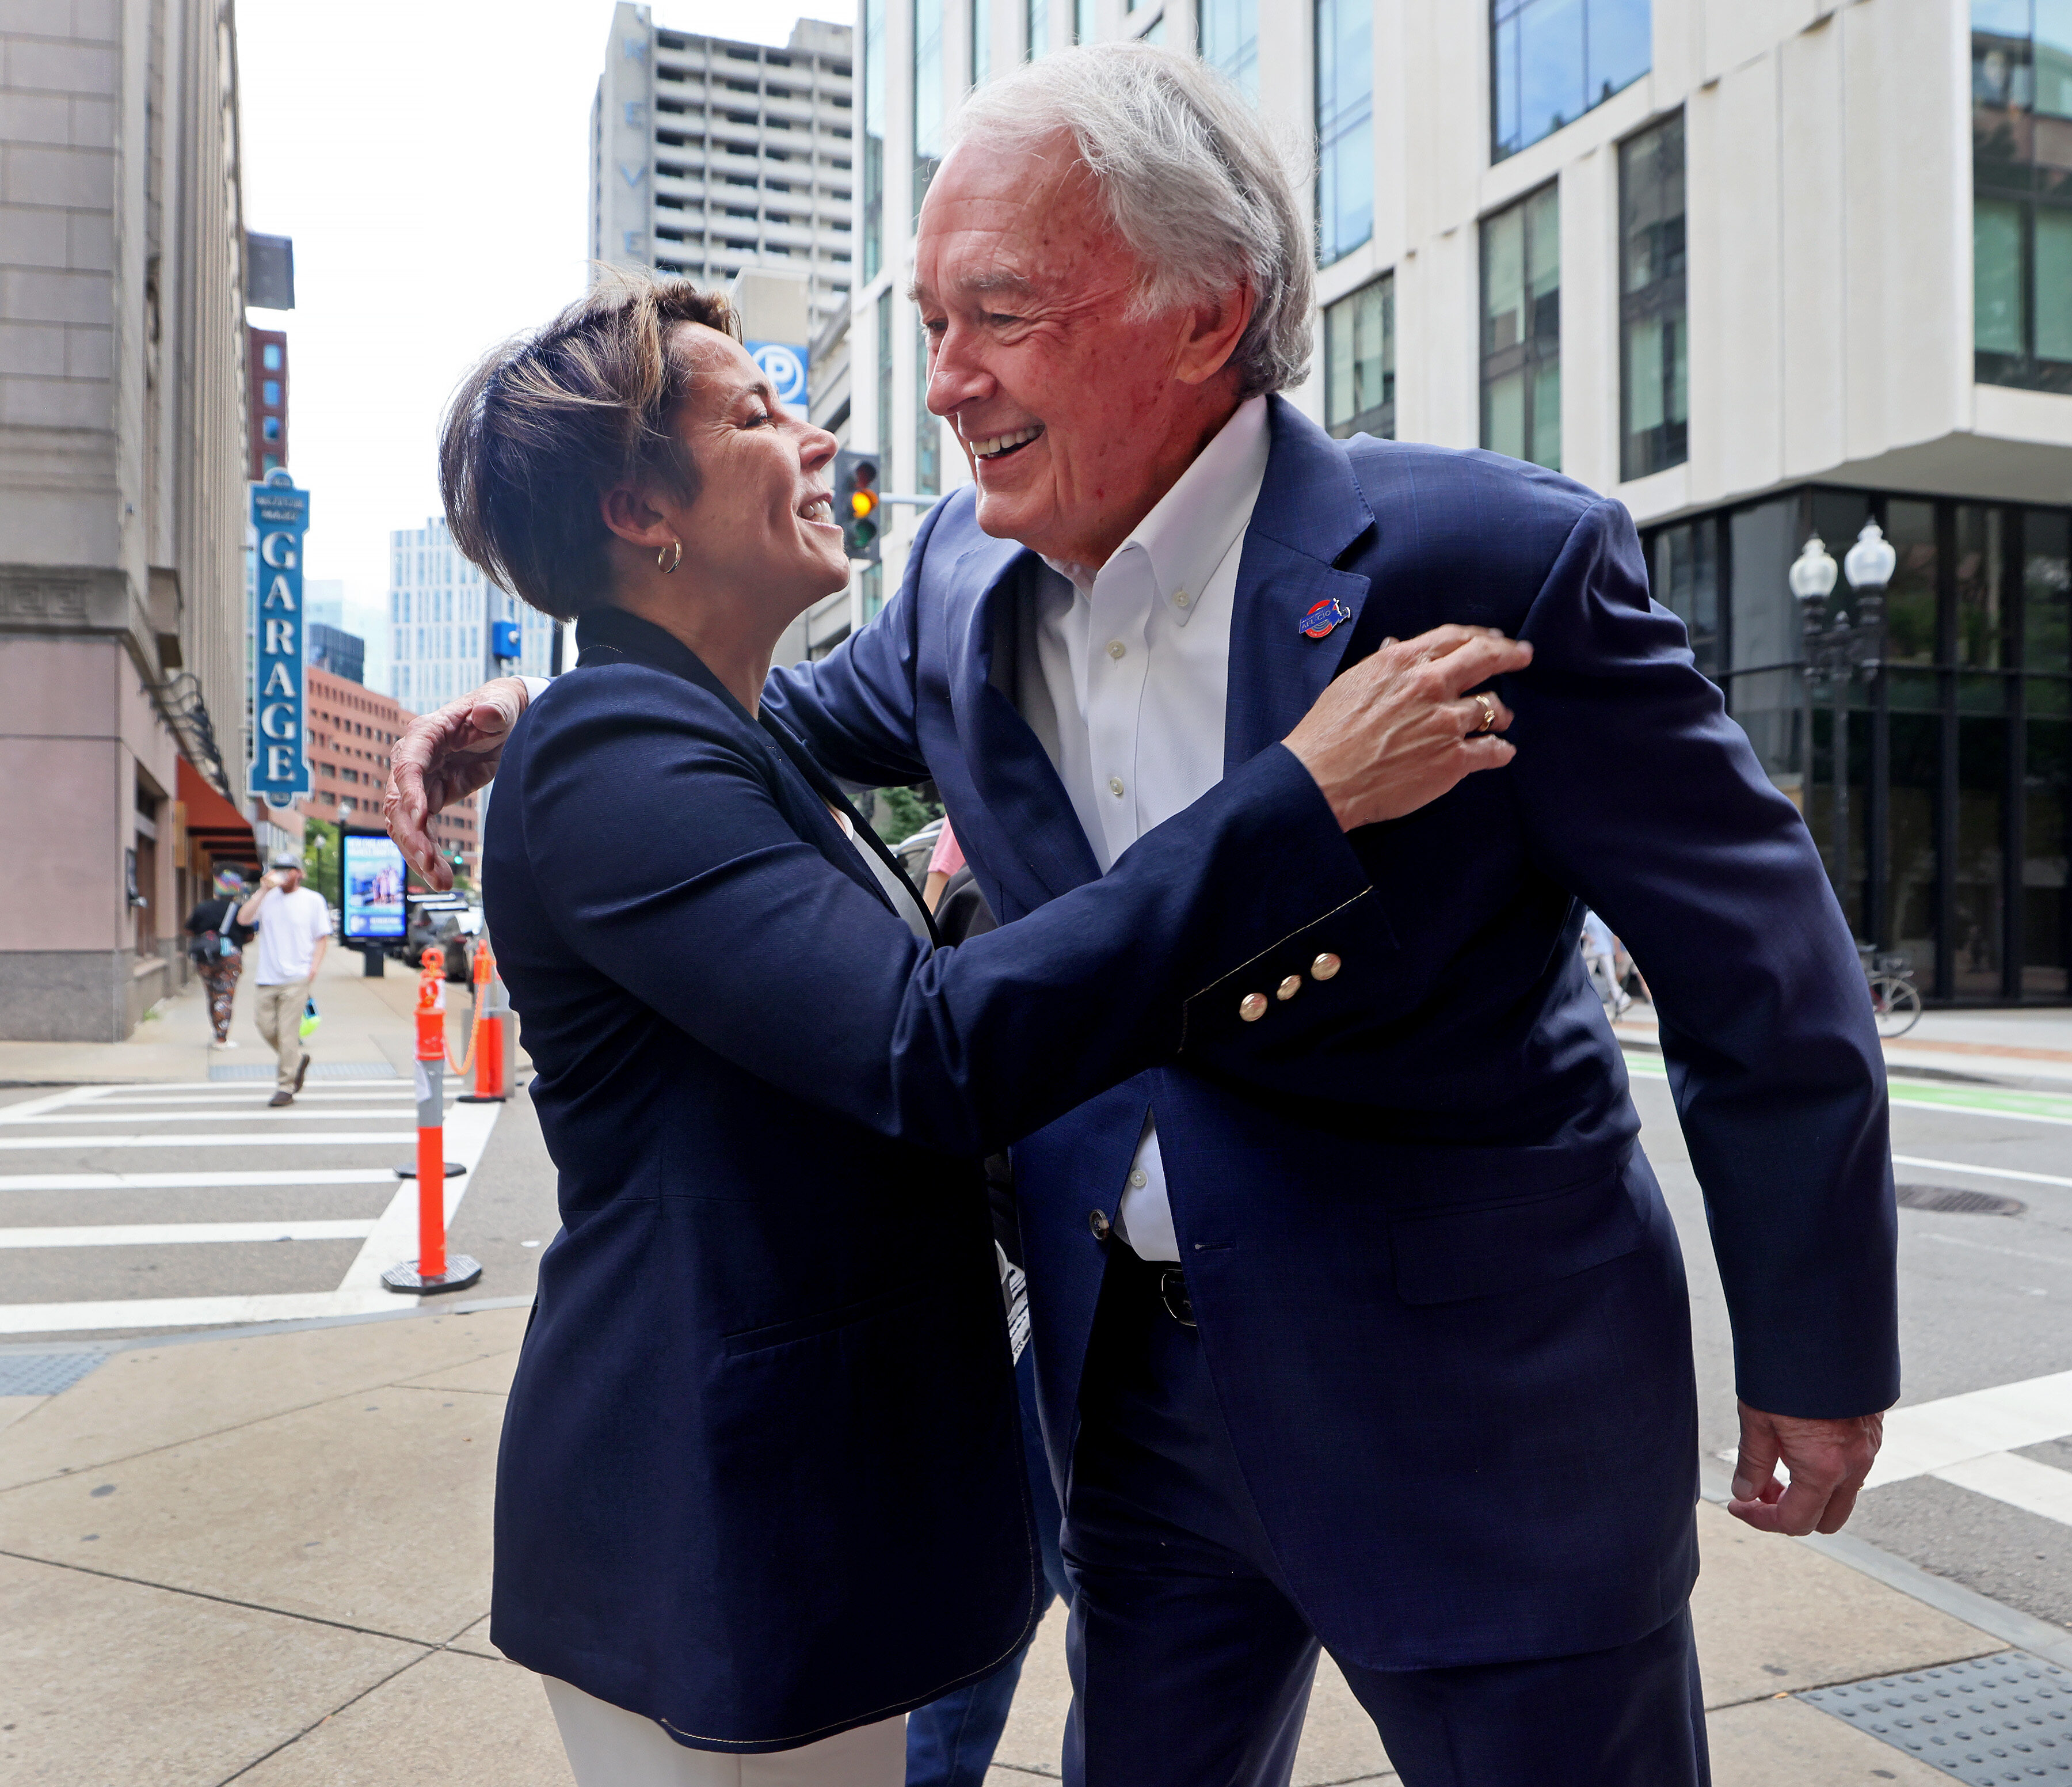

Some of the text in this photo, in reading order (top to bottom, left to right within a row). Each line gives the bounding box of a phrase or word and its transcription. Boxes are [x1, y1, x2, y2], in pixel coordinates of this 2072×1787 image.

[765, 355, 794, 389] P
[1302, 610, 1331, 629] AFL-CIO
[261, 532, 296, 781] GARAGE
